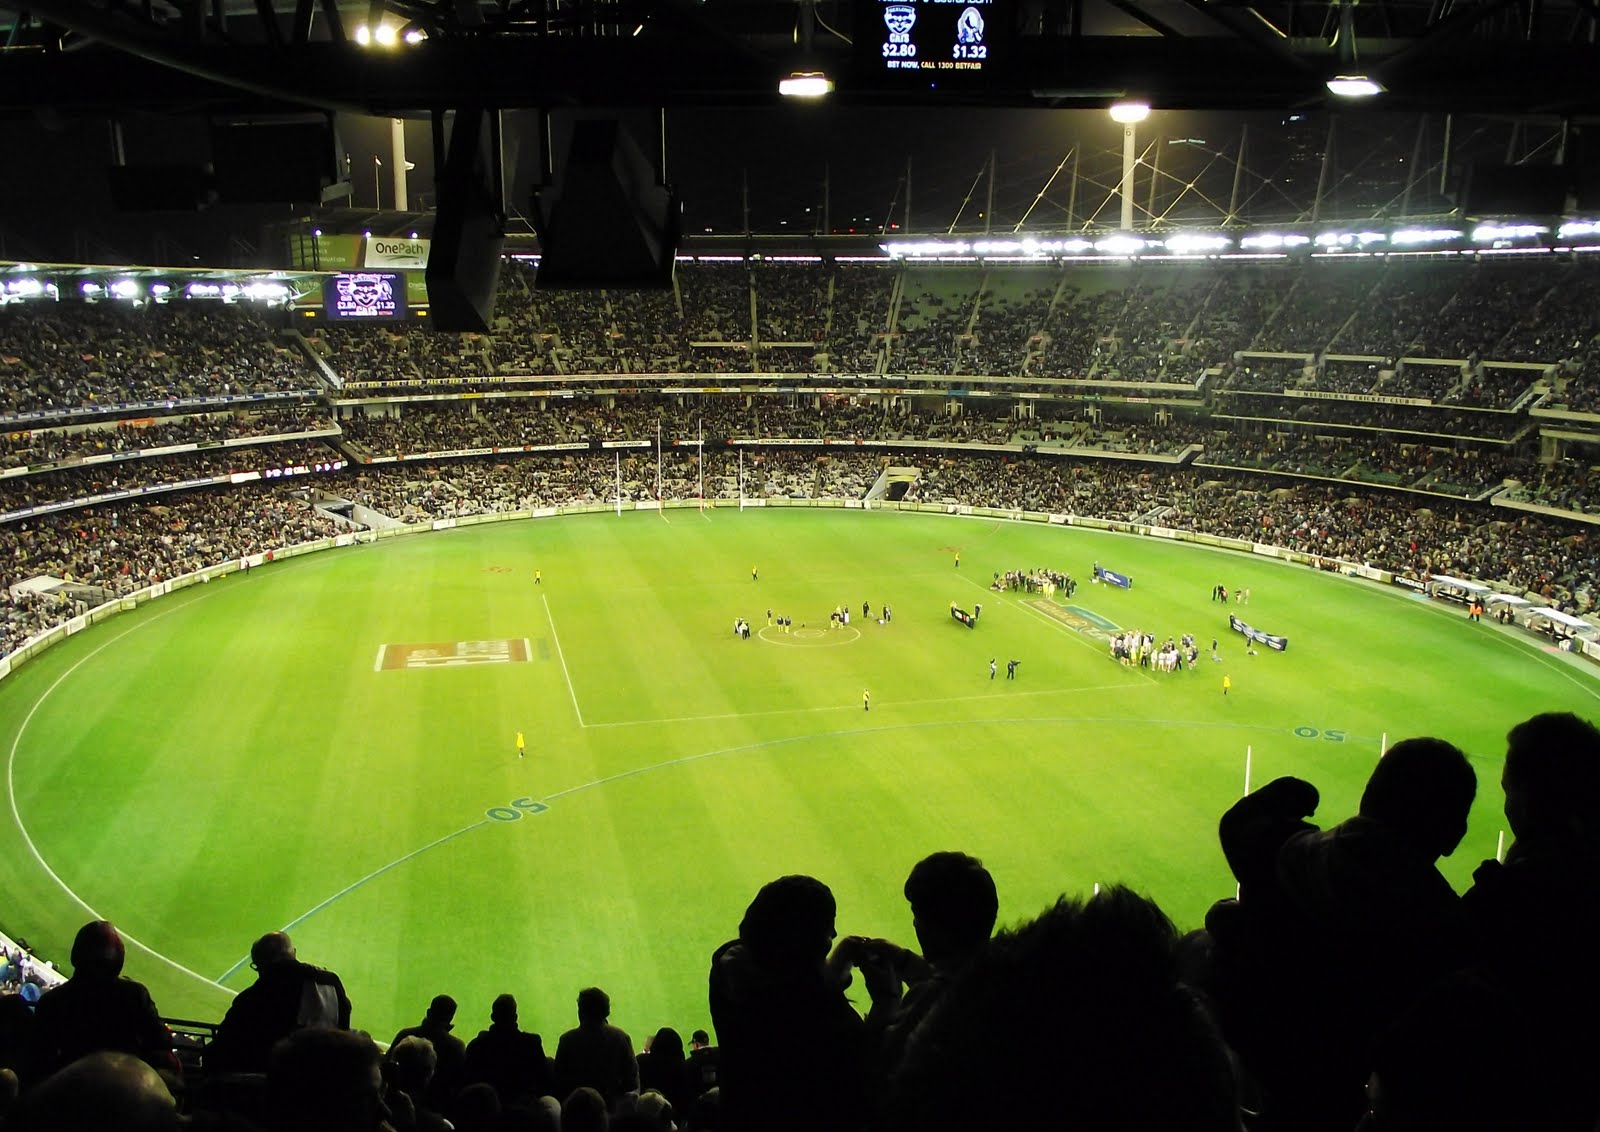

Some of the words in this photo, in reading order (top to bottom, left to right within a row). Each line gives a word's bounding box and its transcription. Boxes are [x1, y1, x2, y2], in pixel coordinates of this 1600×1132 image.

[882, 42, 916, 57] $2.80
[953, 44, 987, 59] $1.32
[887, 60, 900, 69] BET
[901, 61, 920, 70] NOW,
[921, 61, 936, 69] CALL
[938, 61, 954, 69] 1300
[955, 62, 982, 70] BETFAIR
[375, 242, 424, 255] OnePath
[1303, 391, 1349, 400] MELBOURNE
[1353, 395, 1386, 403] CRICKET
[1292, 725, 1348, 744] 50
[484, 796, 550, 822] 50
